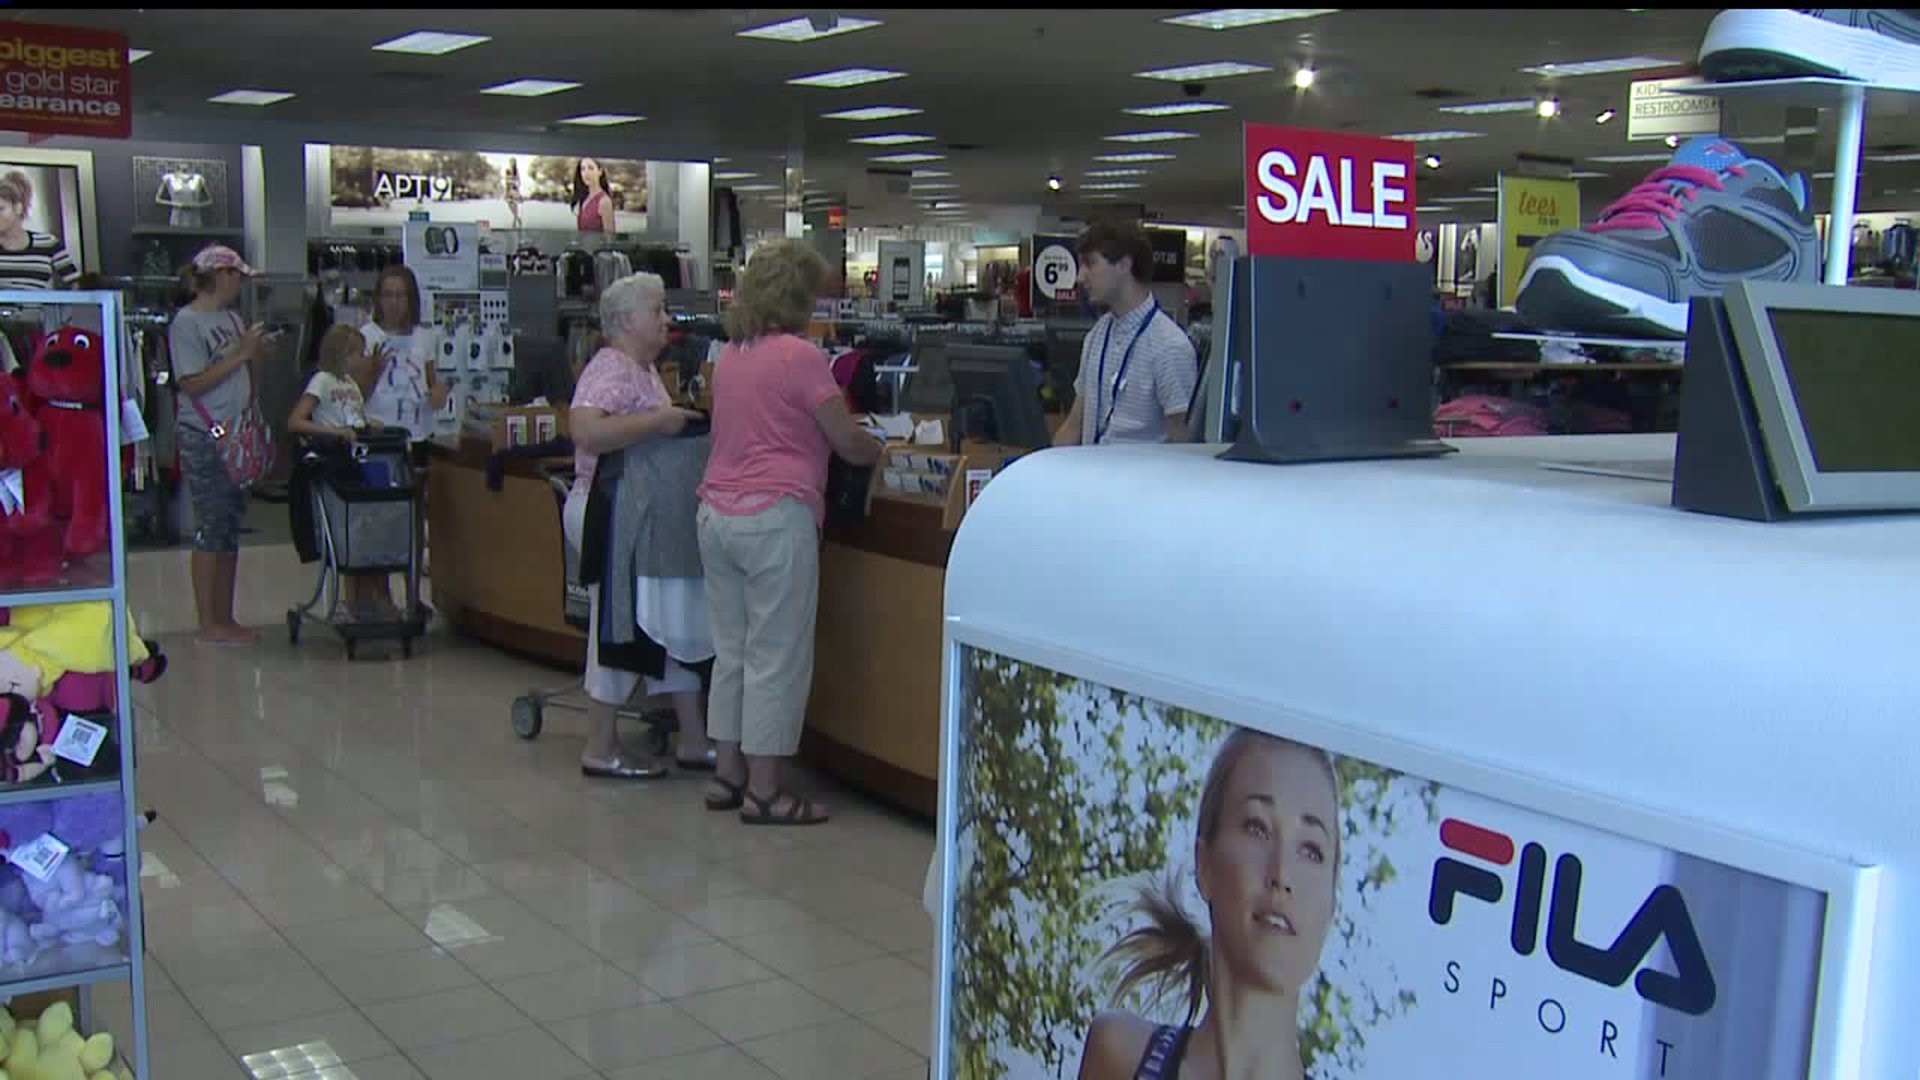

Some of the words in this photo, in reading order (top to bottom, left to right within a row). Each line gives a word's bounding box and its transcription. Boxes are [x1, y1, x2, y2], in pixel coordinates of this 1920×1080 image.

[6, 69, 65, 94] gold
[71, 74, 120, 97] star
[1634, 98, 1712, 115] RESTROOMS
[1256, 150, 1408, 230] SALE
[1518, 191, 1557, 216] tees
[1428, 817, 1717, 1016] FILA
[1443, 960, 1675, 1078] SPORT
